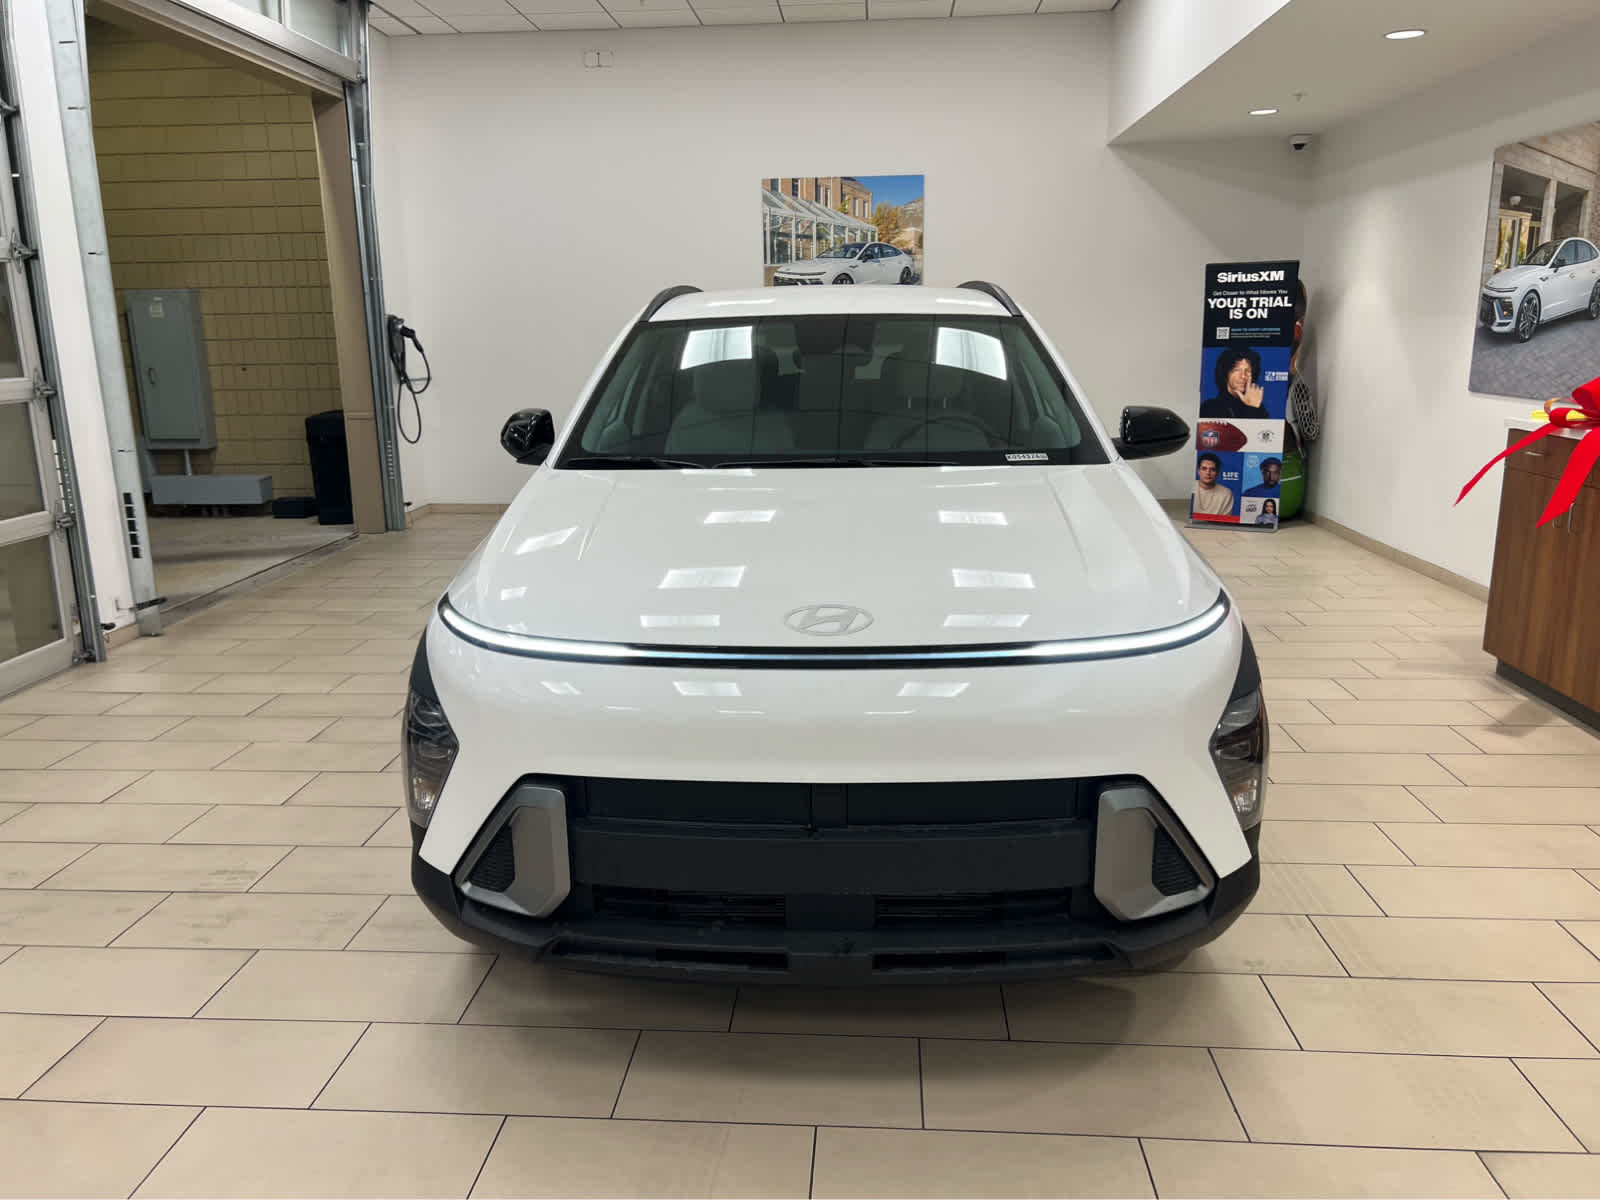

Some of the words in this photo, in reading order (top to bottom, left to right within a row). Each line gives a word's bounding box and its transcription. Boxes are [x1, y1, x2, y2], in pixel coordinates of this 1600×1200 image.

[1217, 270, 1285, 283] SiriusXM
[1207, 297, 1247, 309] YOUR
[1249, 296, 1292, 308] TRIAL
[1229, 308, 1243, 319] IS
[1246, 308, 1268, 319] ON
